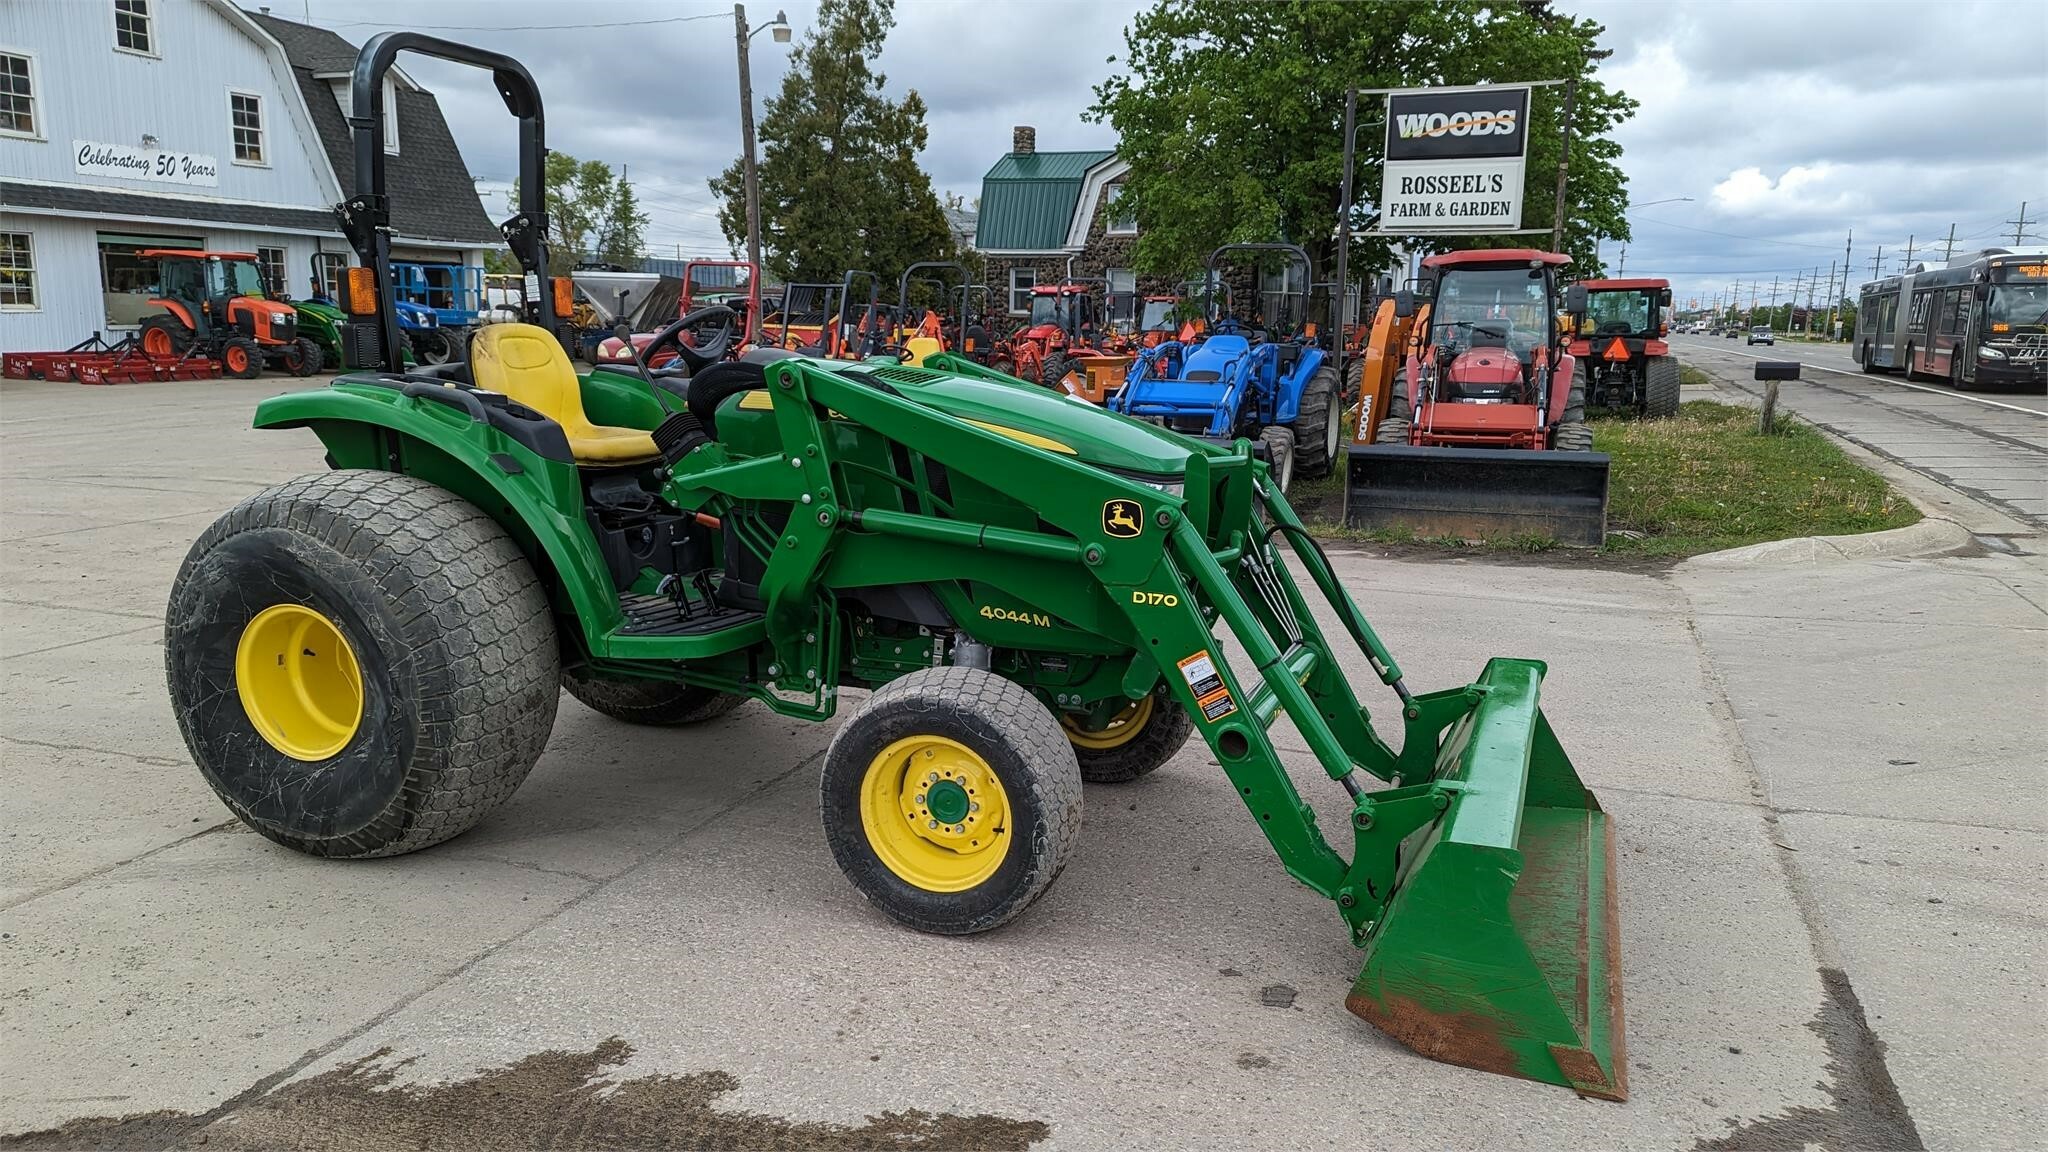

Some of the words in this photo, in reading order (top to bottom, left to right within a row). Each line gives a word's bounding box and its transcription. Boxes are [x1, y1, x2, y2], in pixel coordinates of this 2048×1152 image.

[1396, 109, 1516, 139] WOODS
[78, 144, 150, 176] Celebrating
[156, 154, 176, 177] 50
[181, 156, 216, 179] Years
[1400, 173, 1503, 195] ROSSEEL'S
[1390, 202, 1431, 217] FARM
[1434, 201, 1446, 217] &
[1449, 201, 1511, 217] GARDEN
[1358, 394, 1372, 440] WOODS
[1132, 591, 1178, 607] D170
